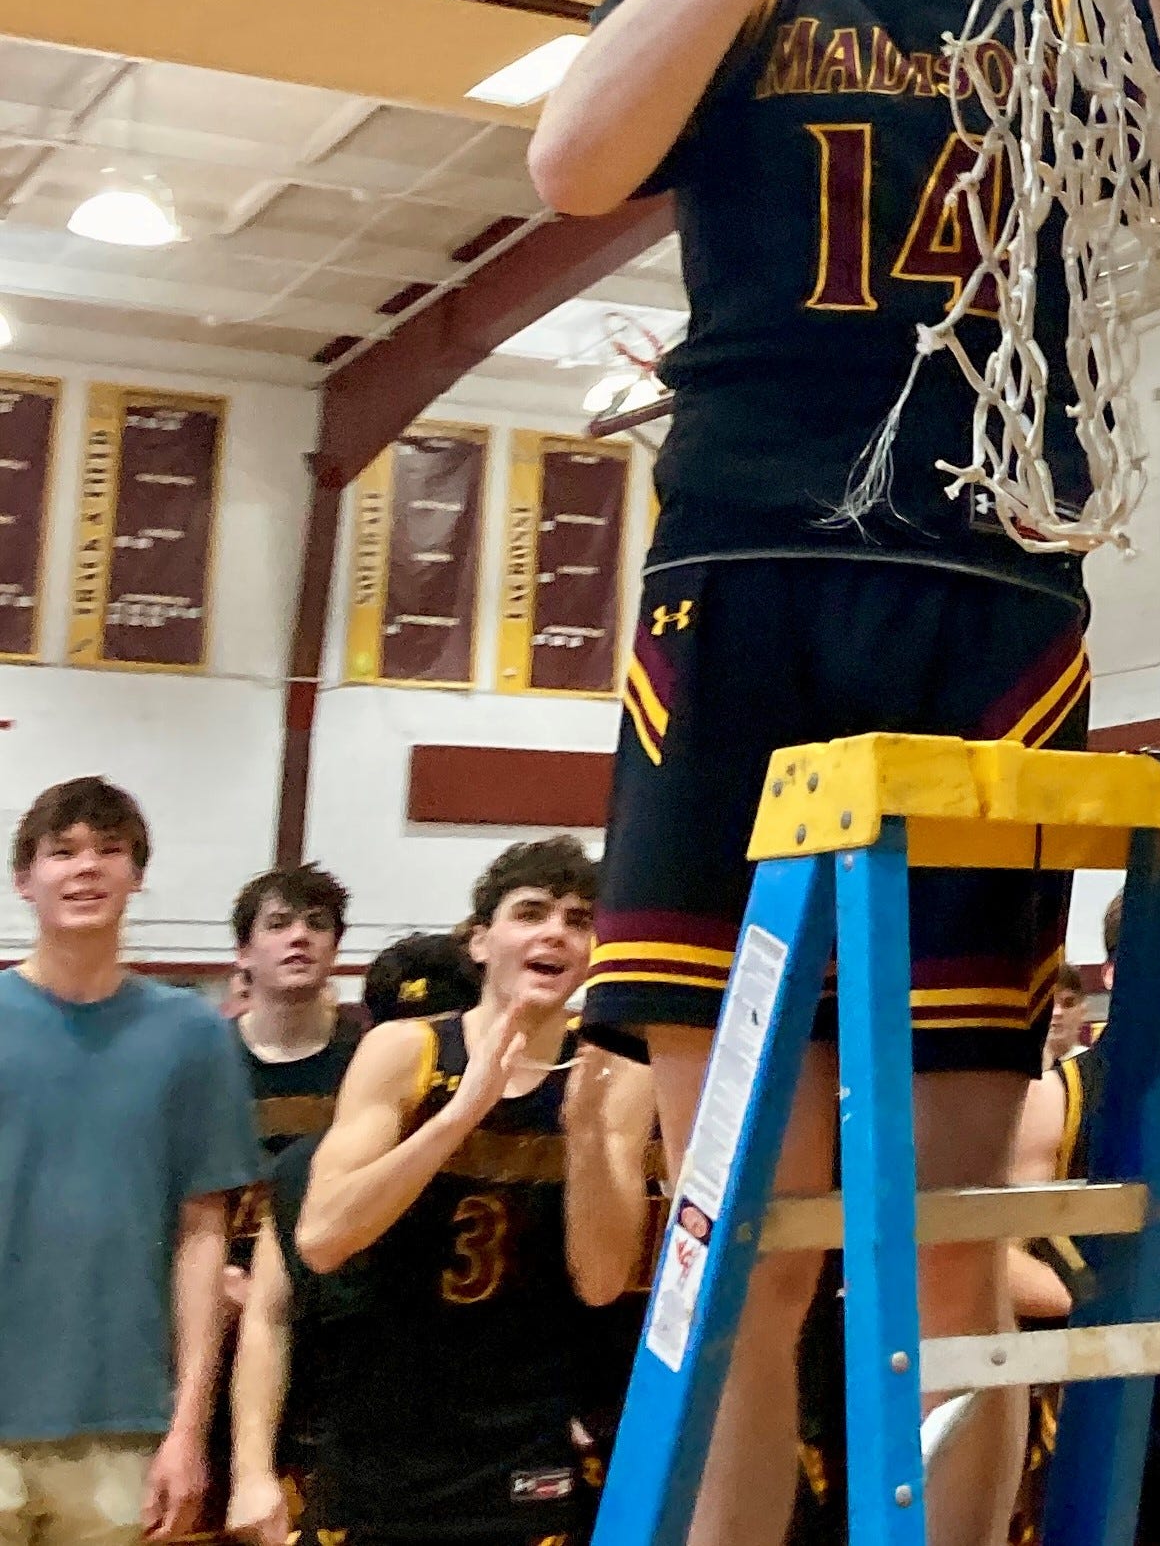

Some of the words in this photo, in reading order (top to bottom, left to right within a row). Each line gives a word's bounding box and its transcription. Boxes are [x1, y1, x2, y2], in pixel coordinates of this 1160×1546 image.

[756, 16, 1059, 110] MADISO
[803, 122, 1011, 320] 14
[442, 1194, 507, 1304] 3
